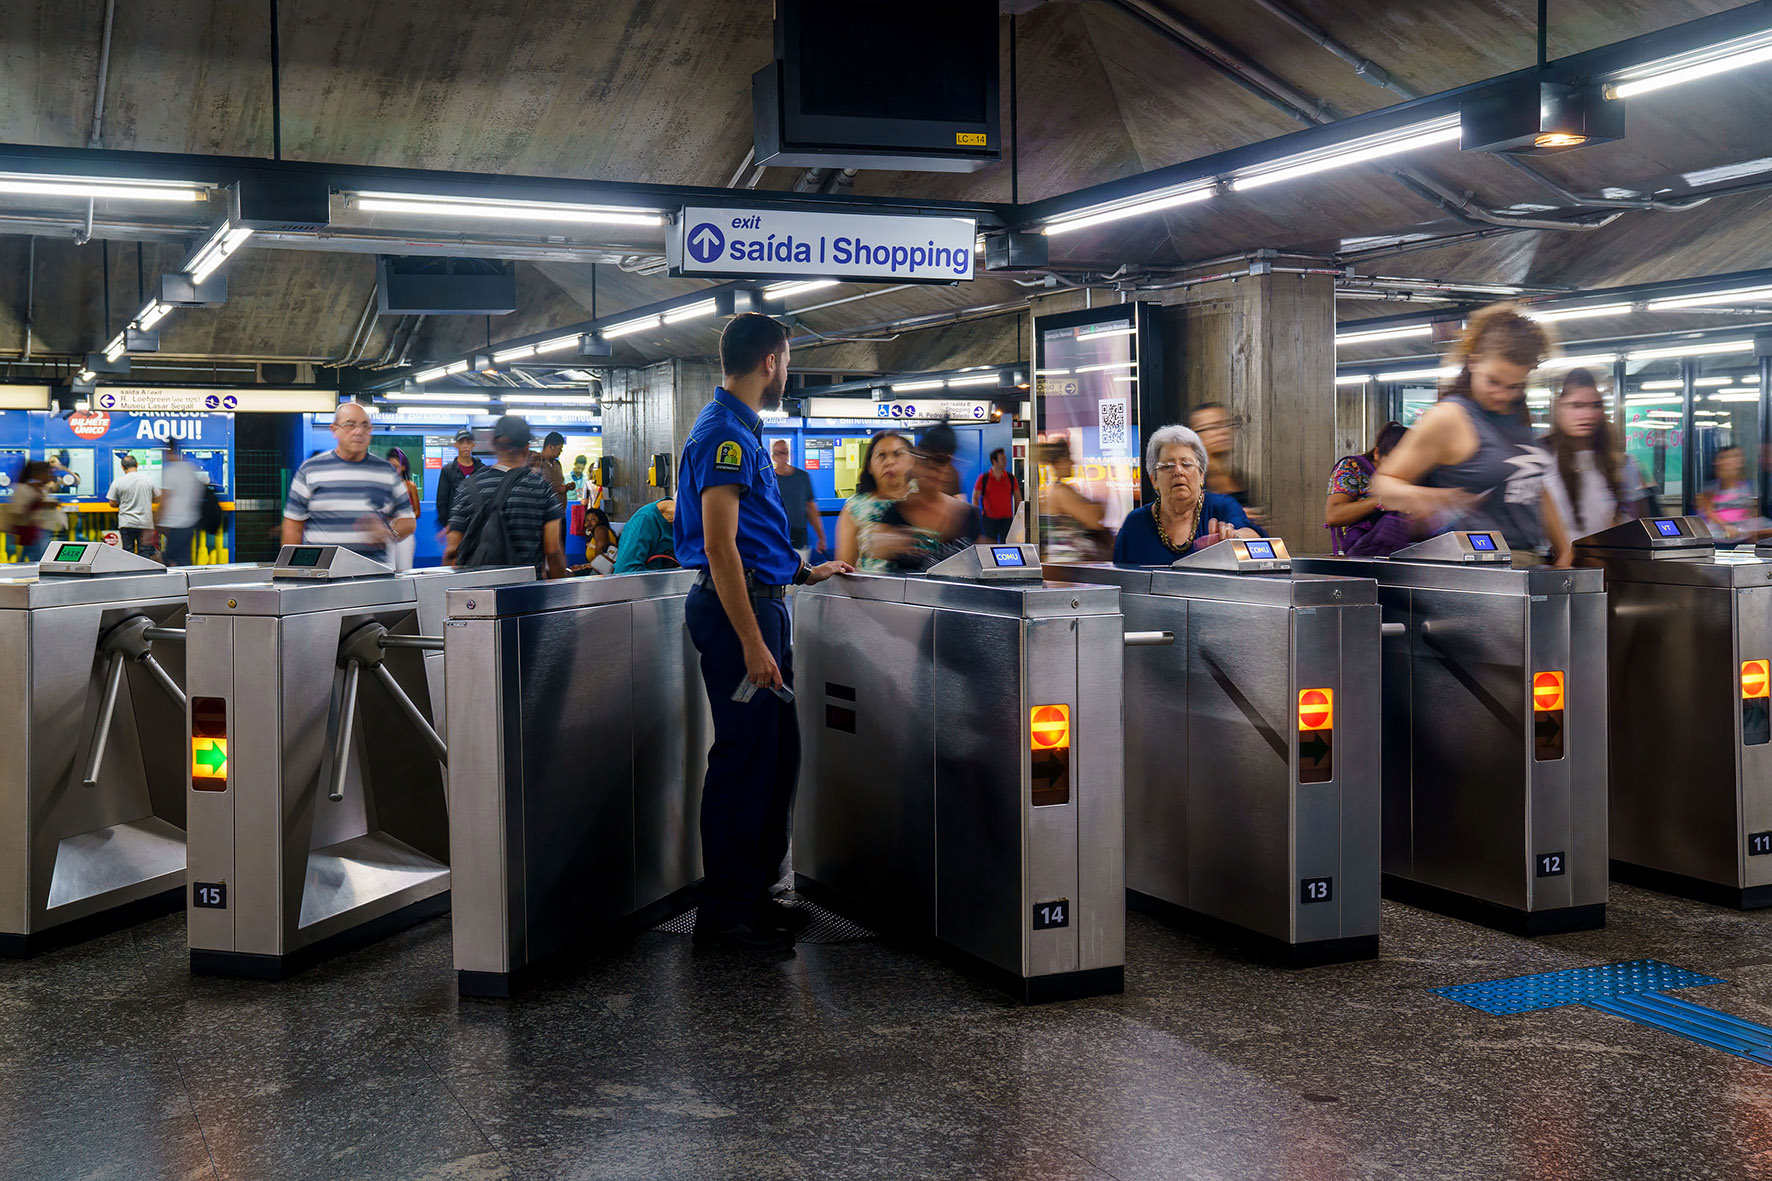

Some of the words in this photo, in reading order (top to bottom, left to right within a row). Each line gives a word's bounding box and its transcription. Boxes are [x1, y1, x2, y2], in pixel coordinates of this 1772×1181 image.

[957, 134, 969, 143] LC
[976, 135, 985, 144] 14
[731, 215, 762, 230] exit
[729, 233, 811, 263] saída
[833, 236, 969, 275] Shopping
[170, 403, 194, 411] Segall
[70, 418, 110, 427] BILHETE
[136, 419, 203, 443] AQUI!
[996, 553, 1019, 561] COMU
[1249, 546, 1270, 554] COMU
[1754, 835, 1770, 851] 11
[1542, 856, 1561, 873] 12
[199, 887, 221, 905] 15
[1307, 881, 1328, 899] 13
[1040, 905, 1064, 924] 14
